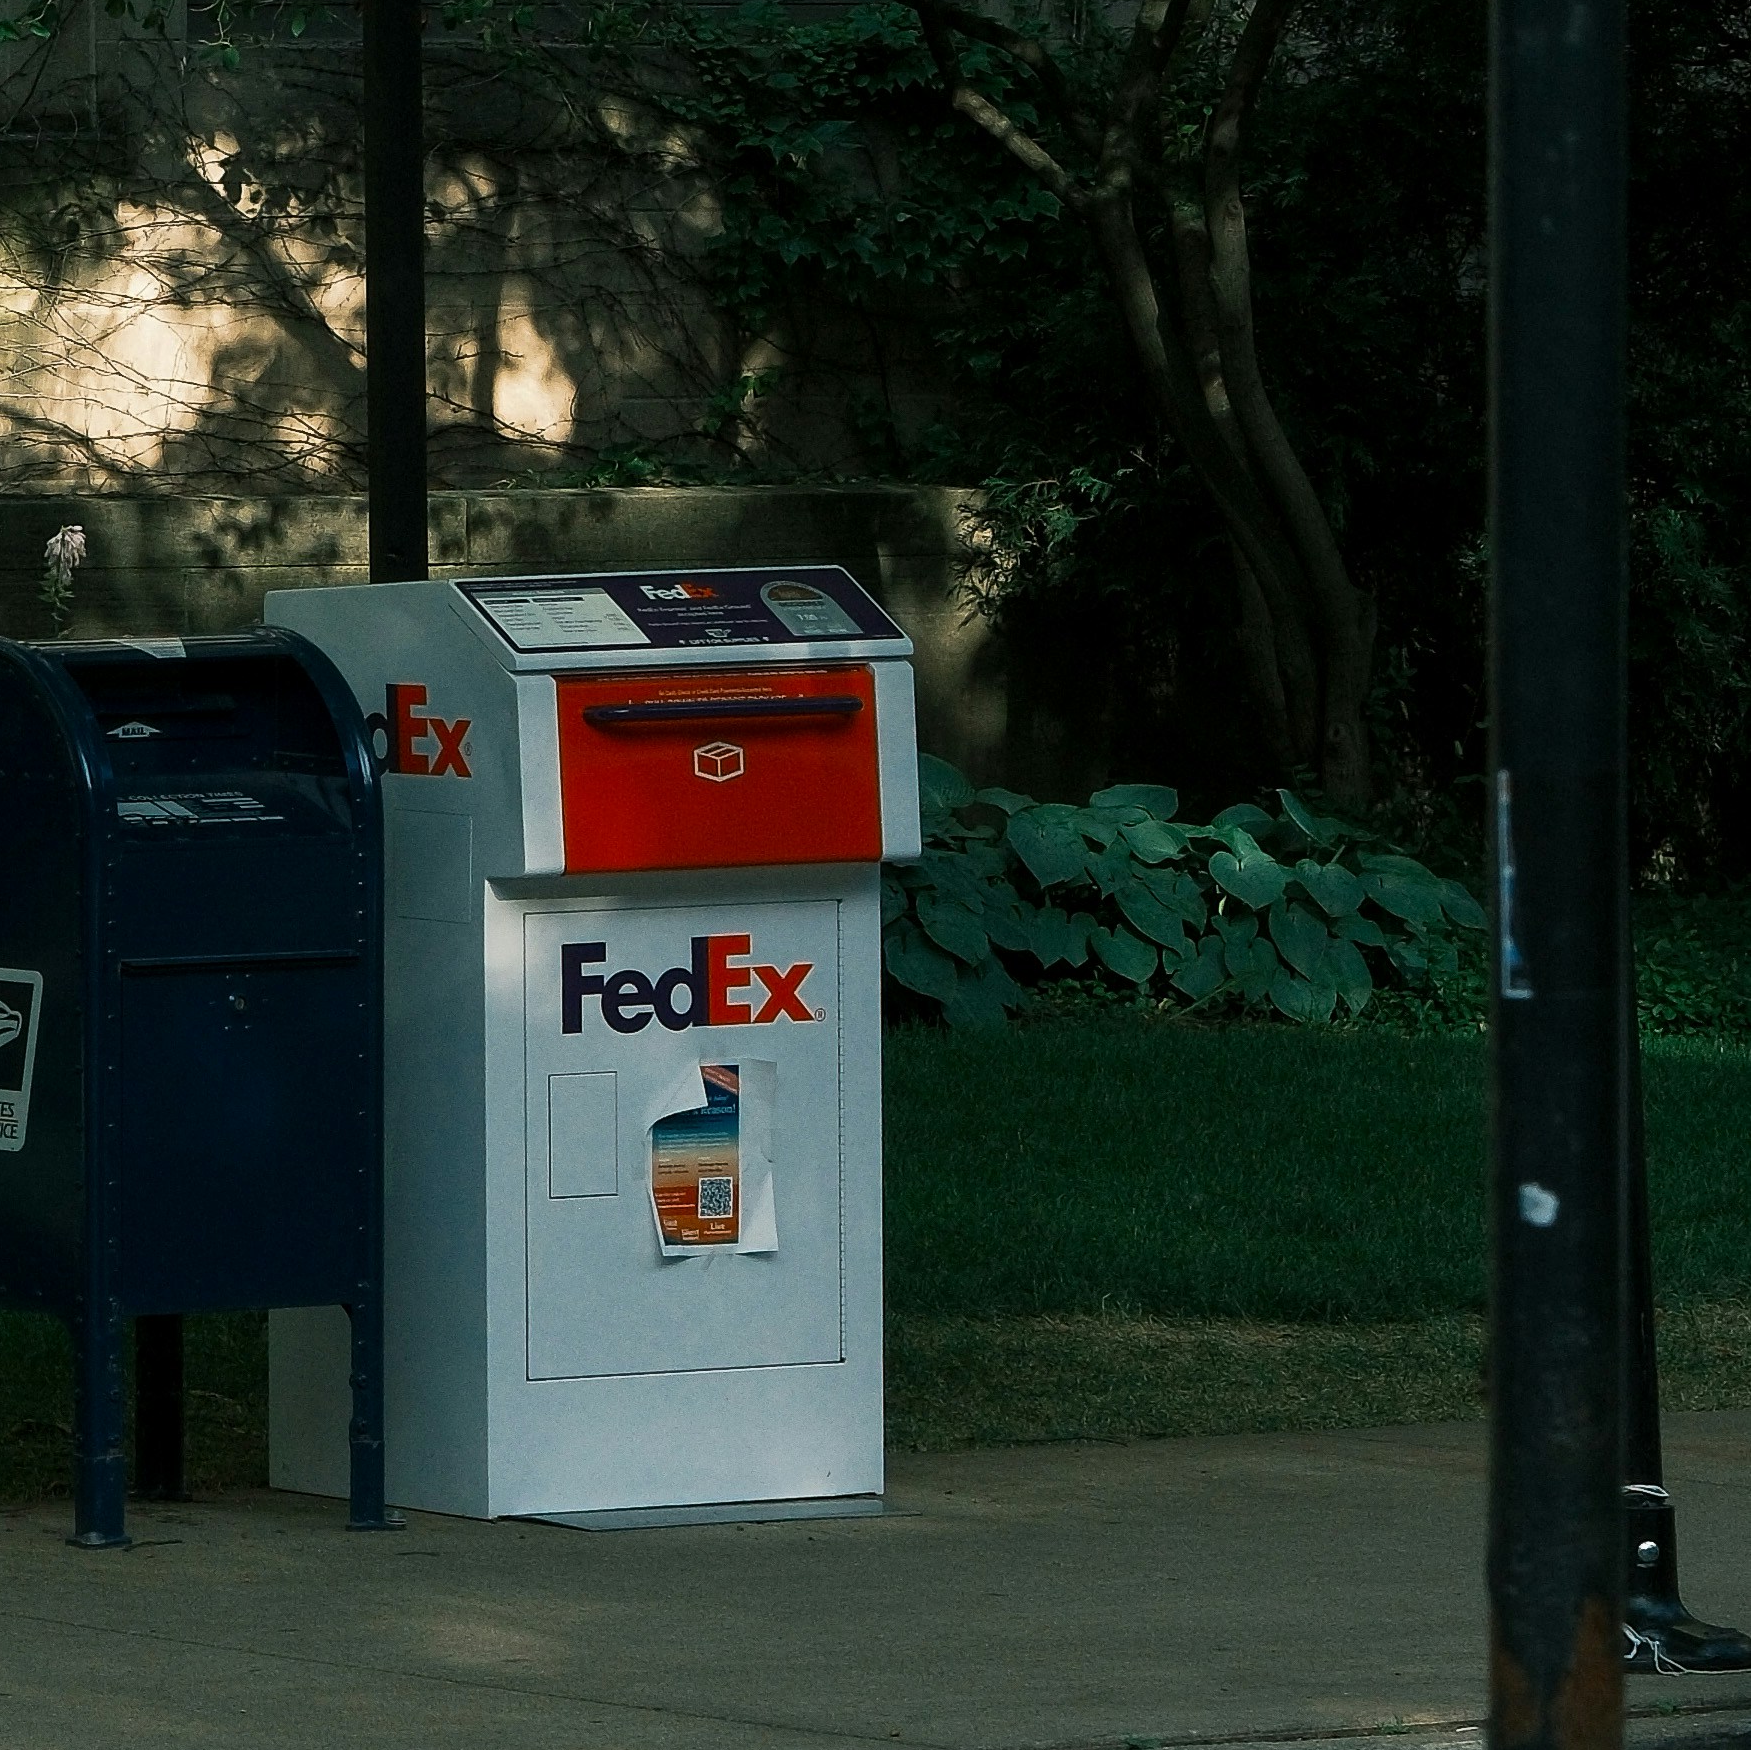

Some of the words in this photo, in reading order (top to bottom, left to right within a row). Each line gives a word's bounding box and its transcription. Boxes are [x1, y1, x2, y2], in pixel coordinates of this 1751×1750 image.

[639, 581, 715, 600] FedEx
[121, 726, 147, 736] MAIL
[364, 683, 472, 778] dEx
[128, 793, 205, 801] COLLECTION
[561, 934, 815, 1035] FedEx
